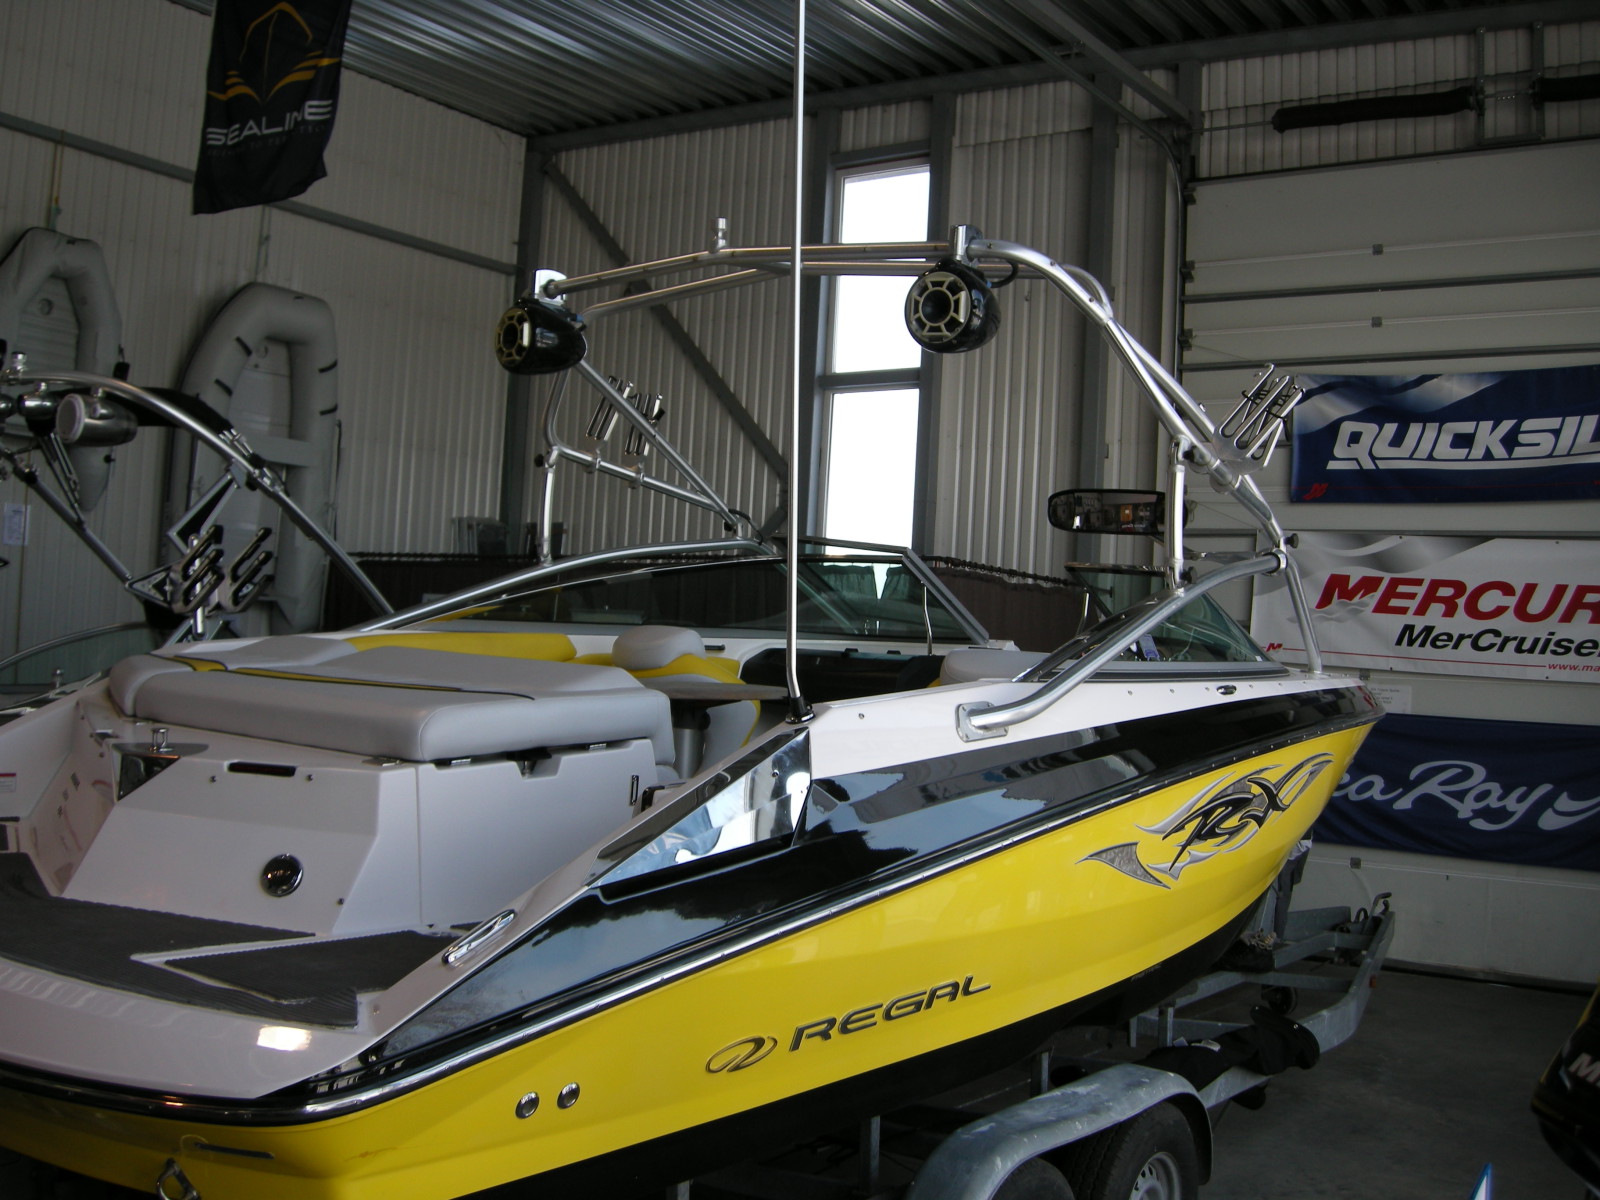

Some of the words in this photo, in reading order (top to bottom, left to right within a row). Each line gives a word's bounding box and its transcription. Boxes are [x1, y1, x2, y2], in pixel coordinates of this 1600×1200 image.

[206, 99, 333, 146] SEALINE
[1331, 414, 1600, 470] QUICKSIL
[1314, 573, 1600, 624] MERCUR
[1394, 623, 1600, 658] MerCruise
[1392, 760, 1555, 831] Ray
[788, 974, 991, 1053] REGAL
